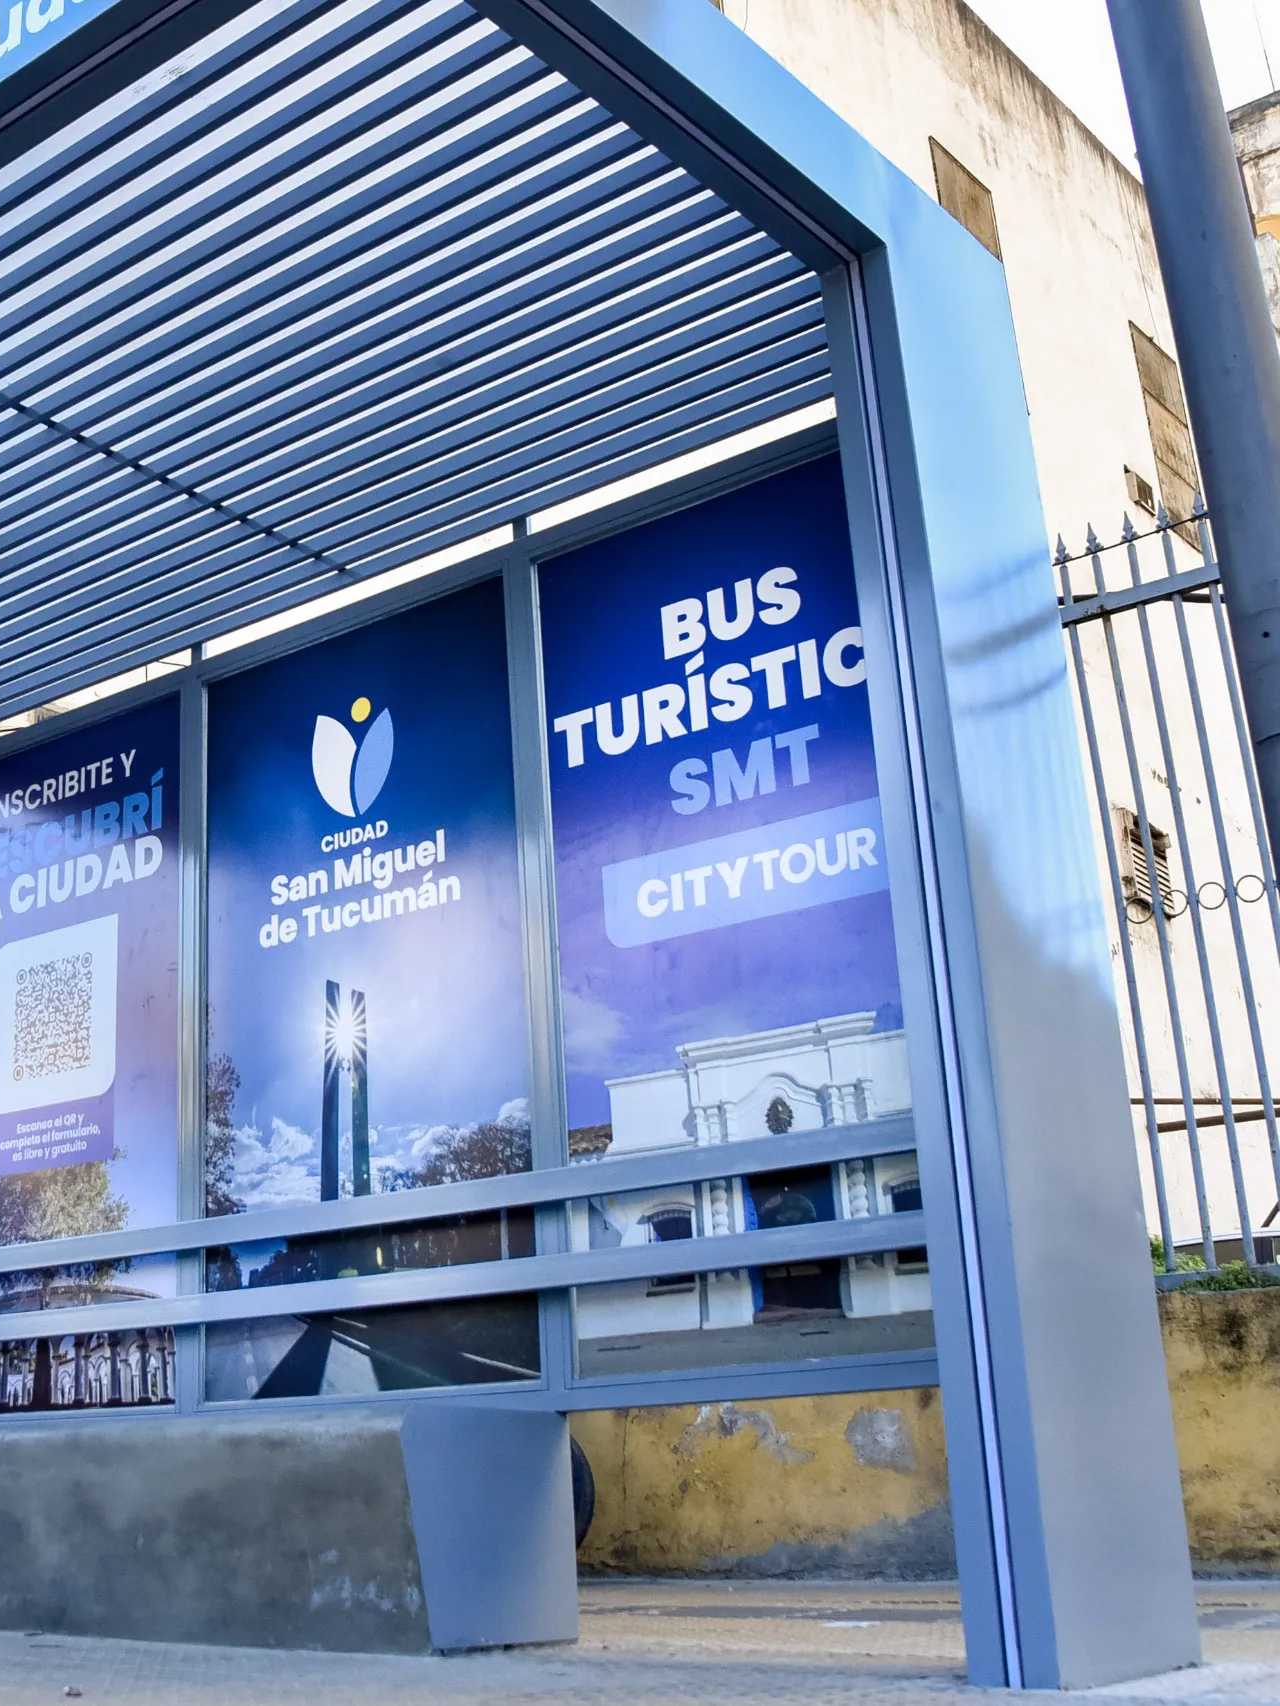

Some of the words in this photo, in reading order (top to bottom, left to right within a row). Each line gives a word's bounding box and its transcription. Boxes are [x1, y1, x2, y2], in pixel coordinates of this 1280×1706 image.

[660, 566, 801, 660] BUS
[554, 626, 867, 769] TURÍSTIC
[120, 749, 136, 777] Y
[669, 723, 820, 816] SMT
[9, 835, 163, 914] CIUDAD
[271, 869, 329, 906] San
[334, 828, 446, 890] Miguel
[321, 820, 389, 852] CIUDAD
[259, 914, 298, 949] de
[302, 870, 461, 938] Tucumán
[12, 1150, 22, 1162] es
[24, 1146, 43, 1160] libre
[52, 1140, 88, 1158] gratuito
[42, 1131, 51, 1142] el
[54, 1115, 62, 1126] el
[64, 1113, 76, 1126] QR
[78, 1113, 84, 1126] y
